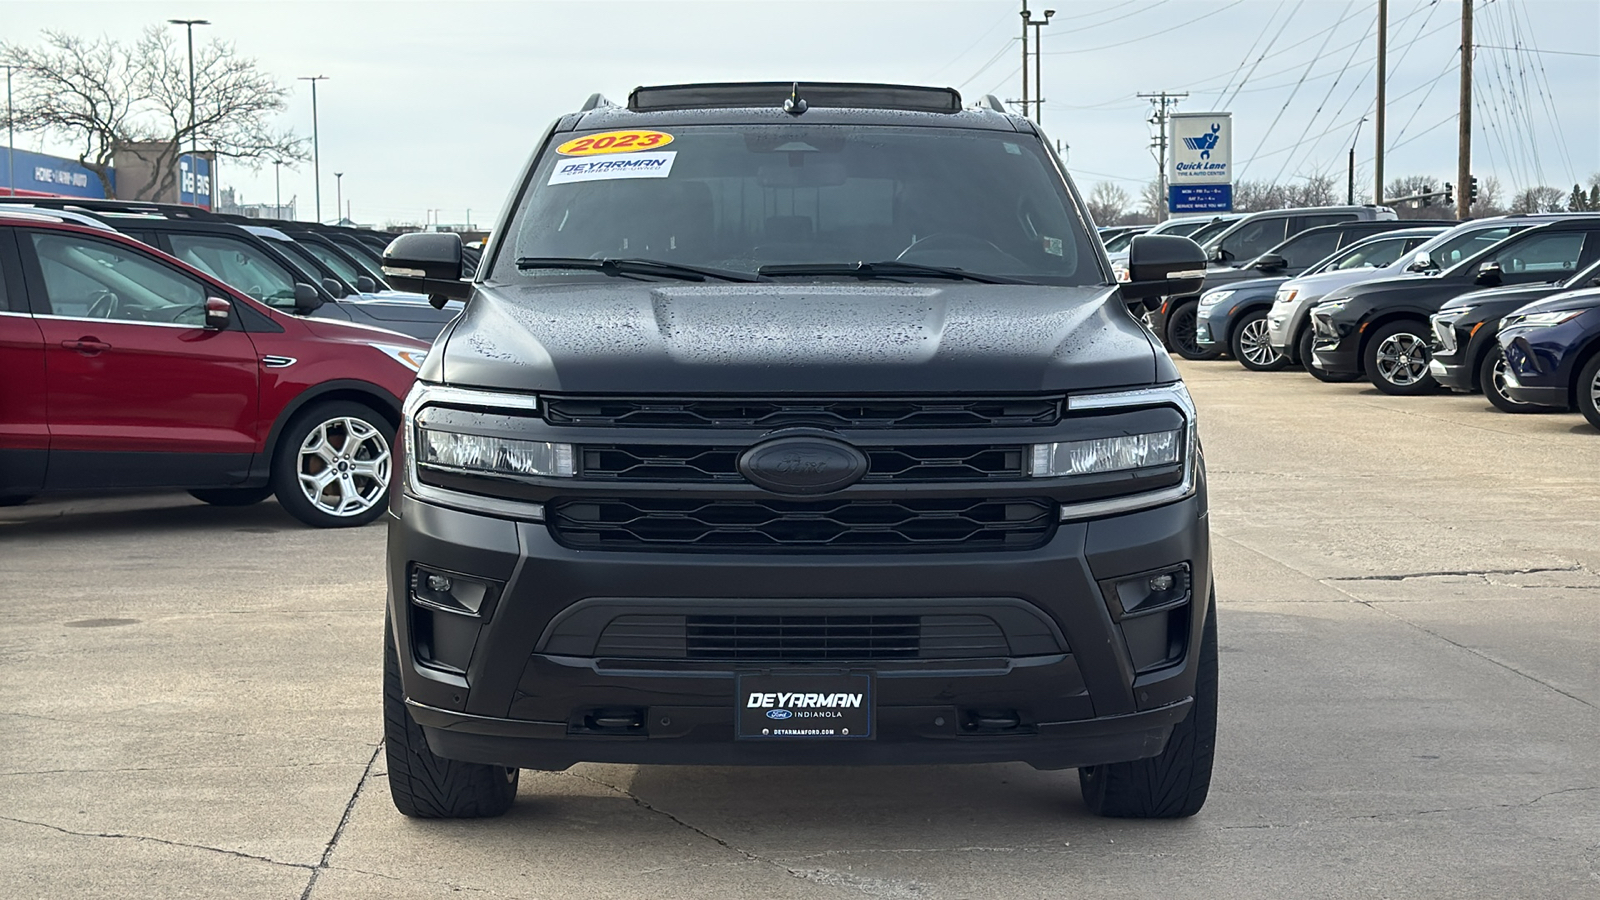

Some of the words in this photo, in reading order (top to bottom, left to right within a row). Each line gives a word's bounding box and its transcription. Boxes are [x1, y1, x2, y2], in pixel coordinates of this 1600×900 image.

[568, 134, 663, 152] 2023
[561, 159, 667, 173] DEYARMAN
[566, 168, 609, 176] CERTIFIED
[1176, 162, 1203, 170] Quick
[777, 452, 833, 474] Ford
[747, 693, 862, 707] DEYARMAN
